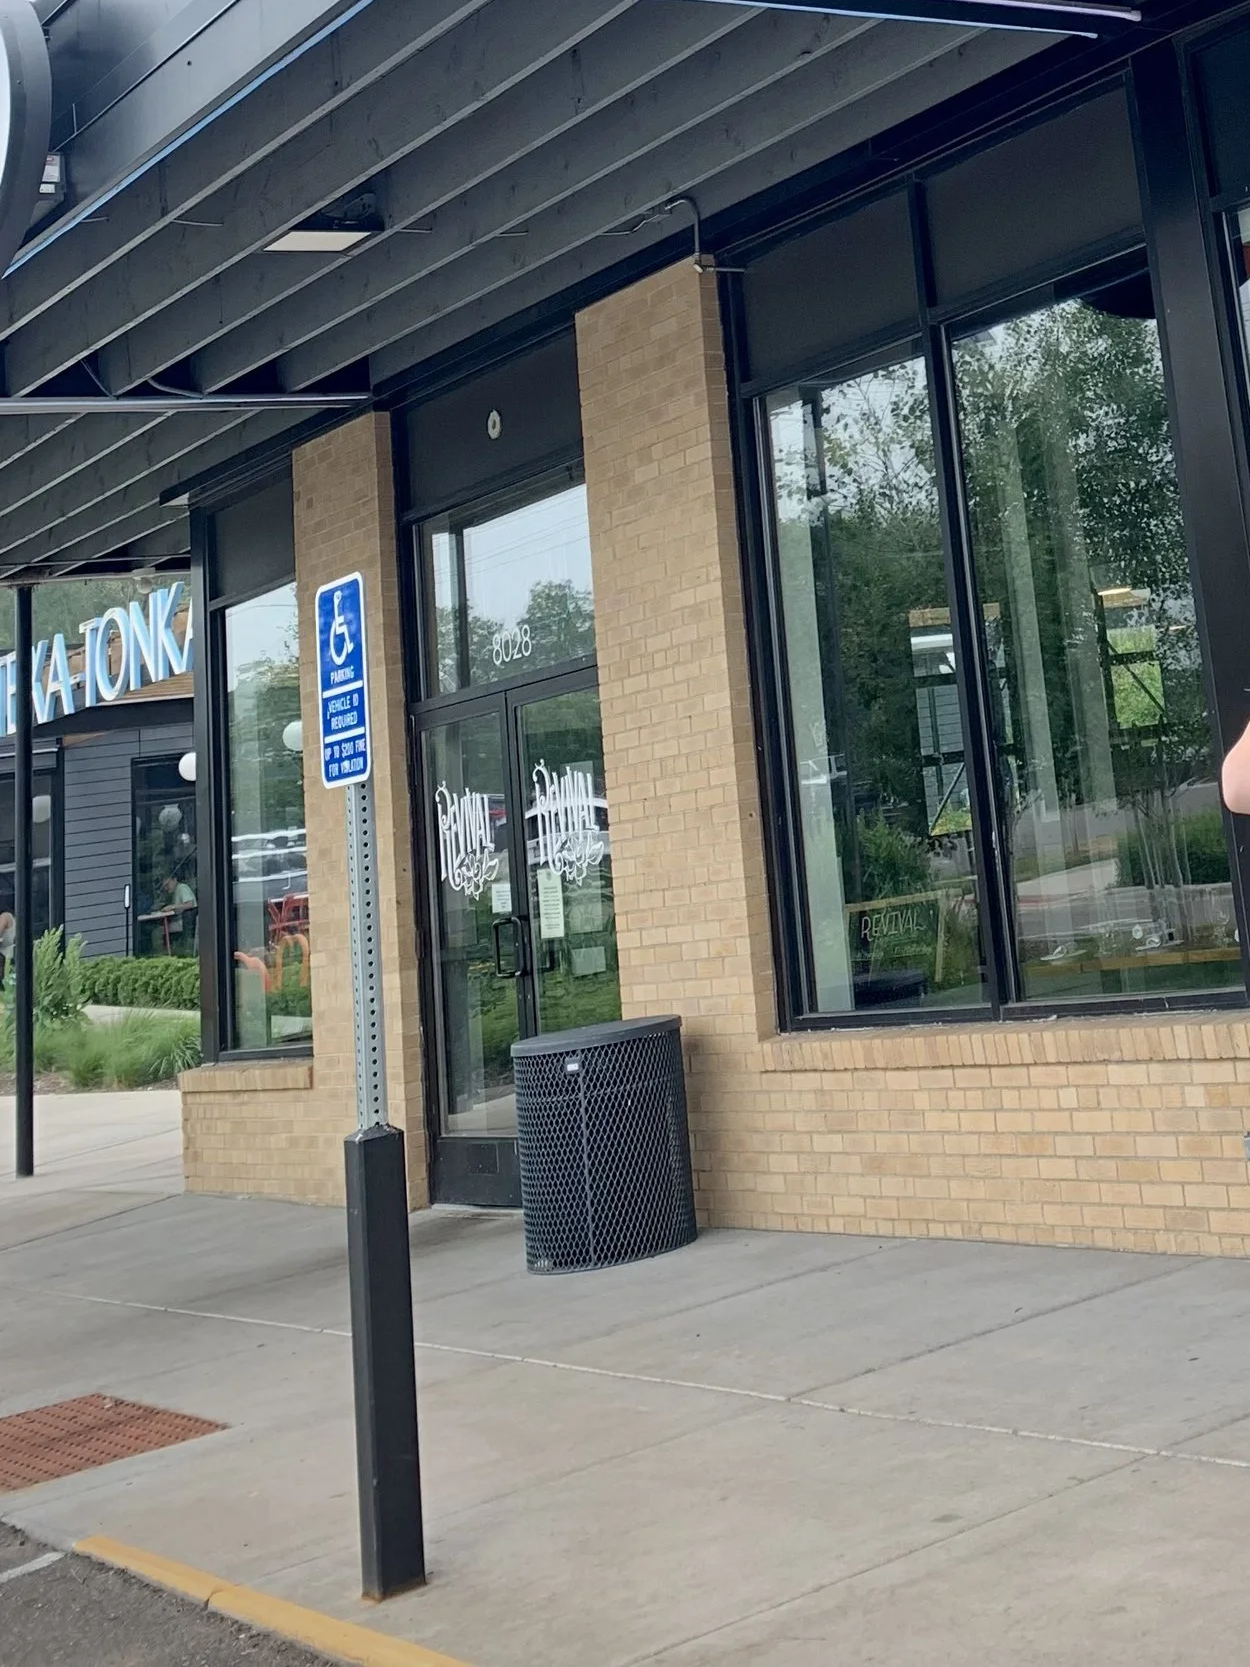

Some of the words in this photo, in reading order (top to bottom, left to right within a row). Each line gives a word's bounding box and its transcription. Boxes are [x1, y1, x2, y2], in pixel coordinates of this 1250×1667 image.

[492, 624, 532, 665] 8028
[330, 665, 355, 685] PARKING
[328, 695, 351, 714] VEHICLE
[352, 693, 359, 707] ID
[331, 711, 358, 730] REQUIRED
[324, 747, 332, 761] UP
[333, 745, 340, 759] TO
[341, 741, 354, 758] $200
[355, 738, 366, 753] FINE
[328, 762, 339, 777] FOR
[340, 756, 364, 774] VIOLATION
[861, 907, 928, 942] REVIVAL
